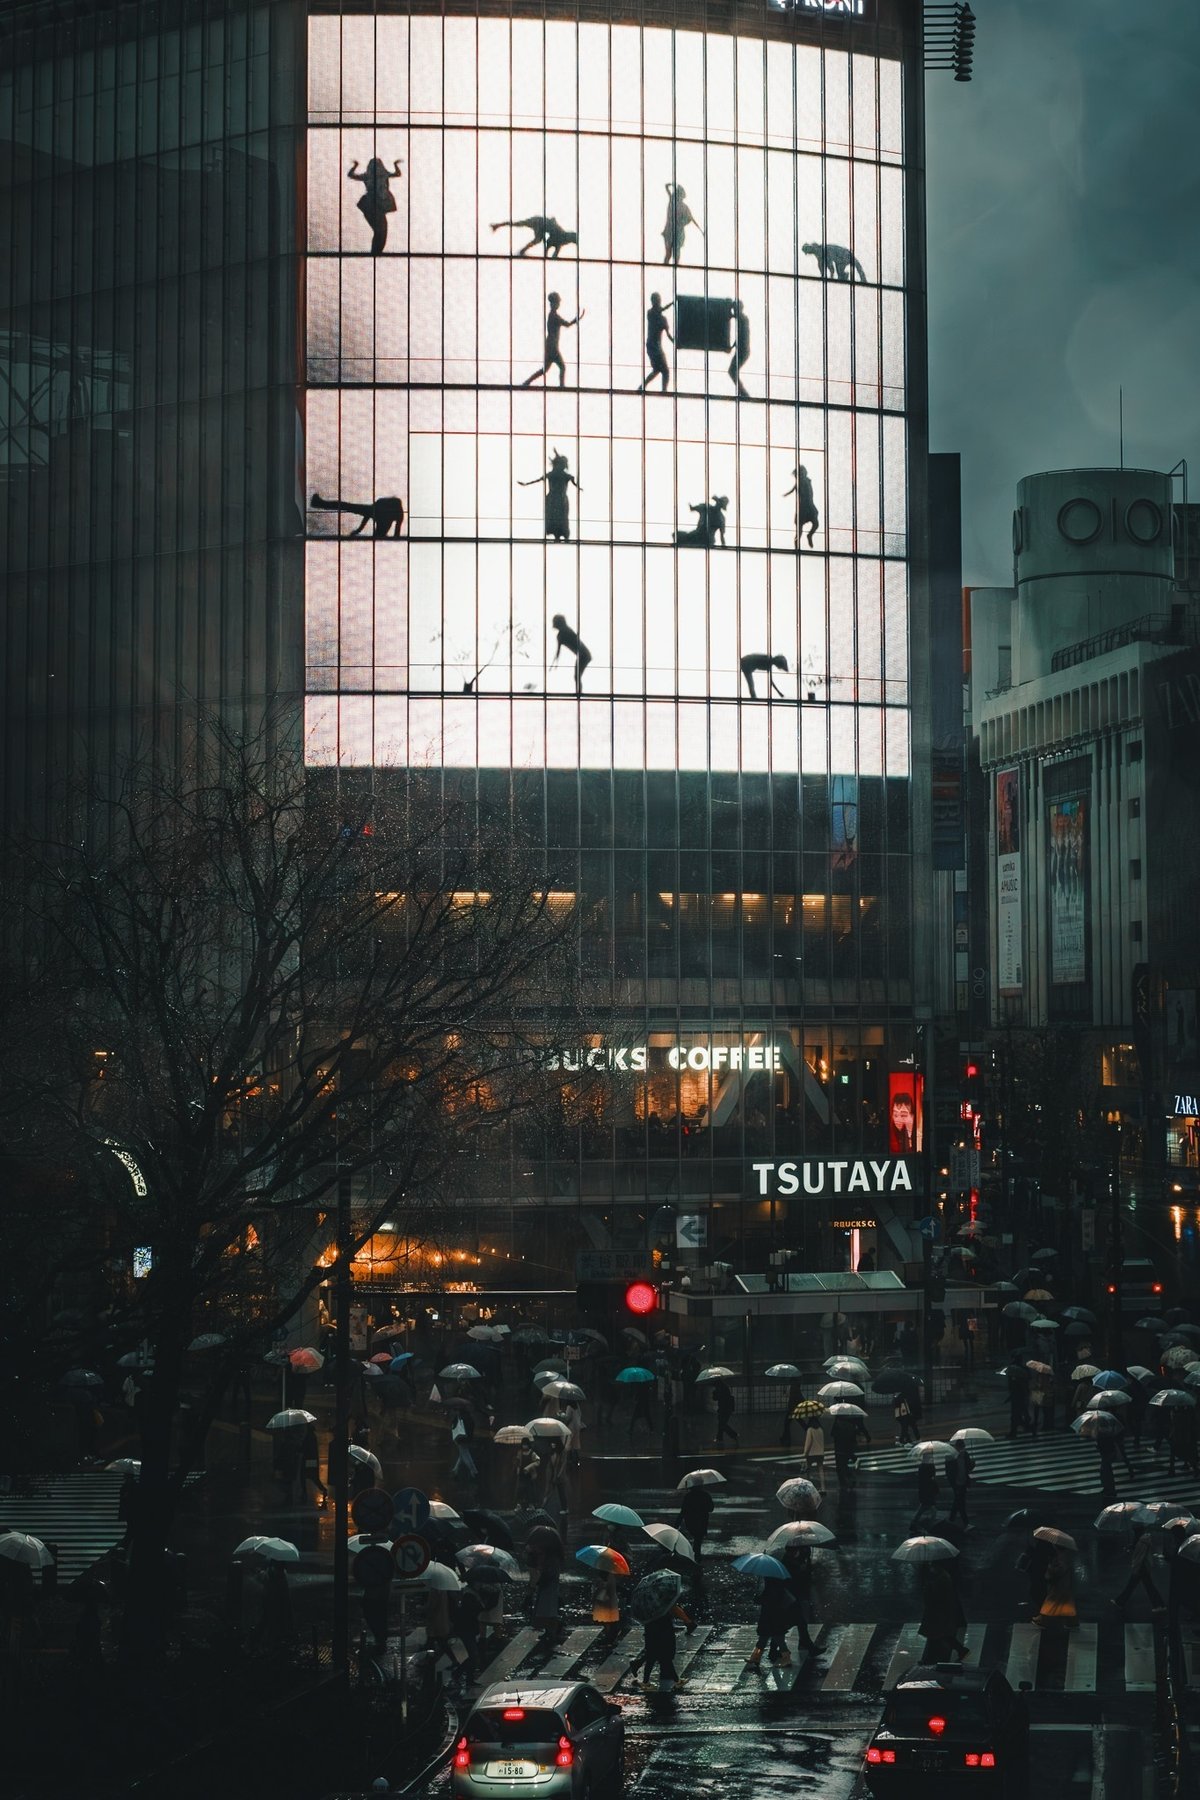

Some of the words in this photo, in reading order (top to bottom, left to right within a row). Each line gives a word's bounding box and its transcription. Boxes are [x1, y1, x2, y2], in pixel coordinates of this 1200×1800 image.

[668, 1046, 782, 1071] COFFEE
[1174, 1095, 1199, 1115] ZARA
[752, 1160, 912, 1195] TSUTAYA
[504, 1766, 523, 1775] 15-80
